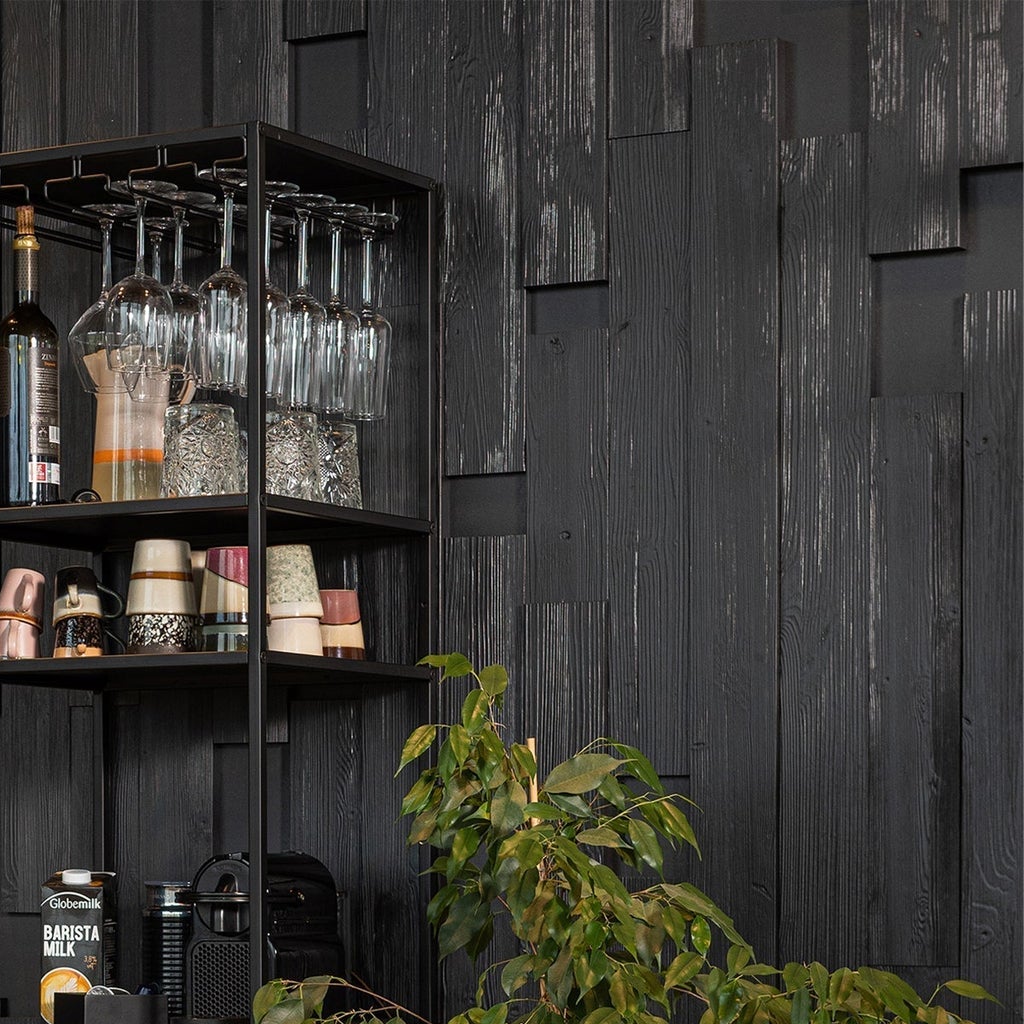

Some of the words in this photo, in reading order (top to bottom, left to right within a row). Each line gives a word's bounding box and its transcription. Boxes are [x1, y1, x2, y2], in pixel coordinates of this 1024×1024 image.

[49, 898, 101, 909] Globemilk
[43, 924, 100, 941] BARISTA
[43, 941, 76, 957] MILK
